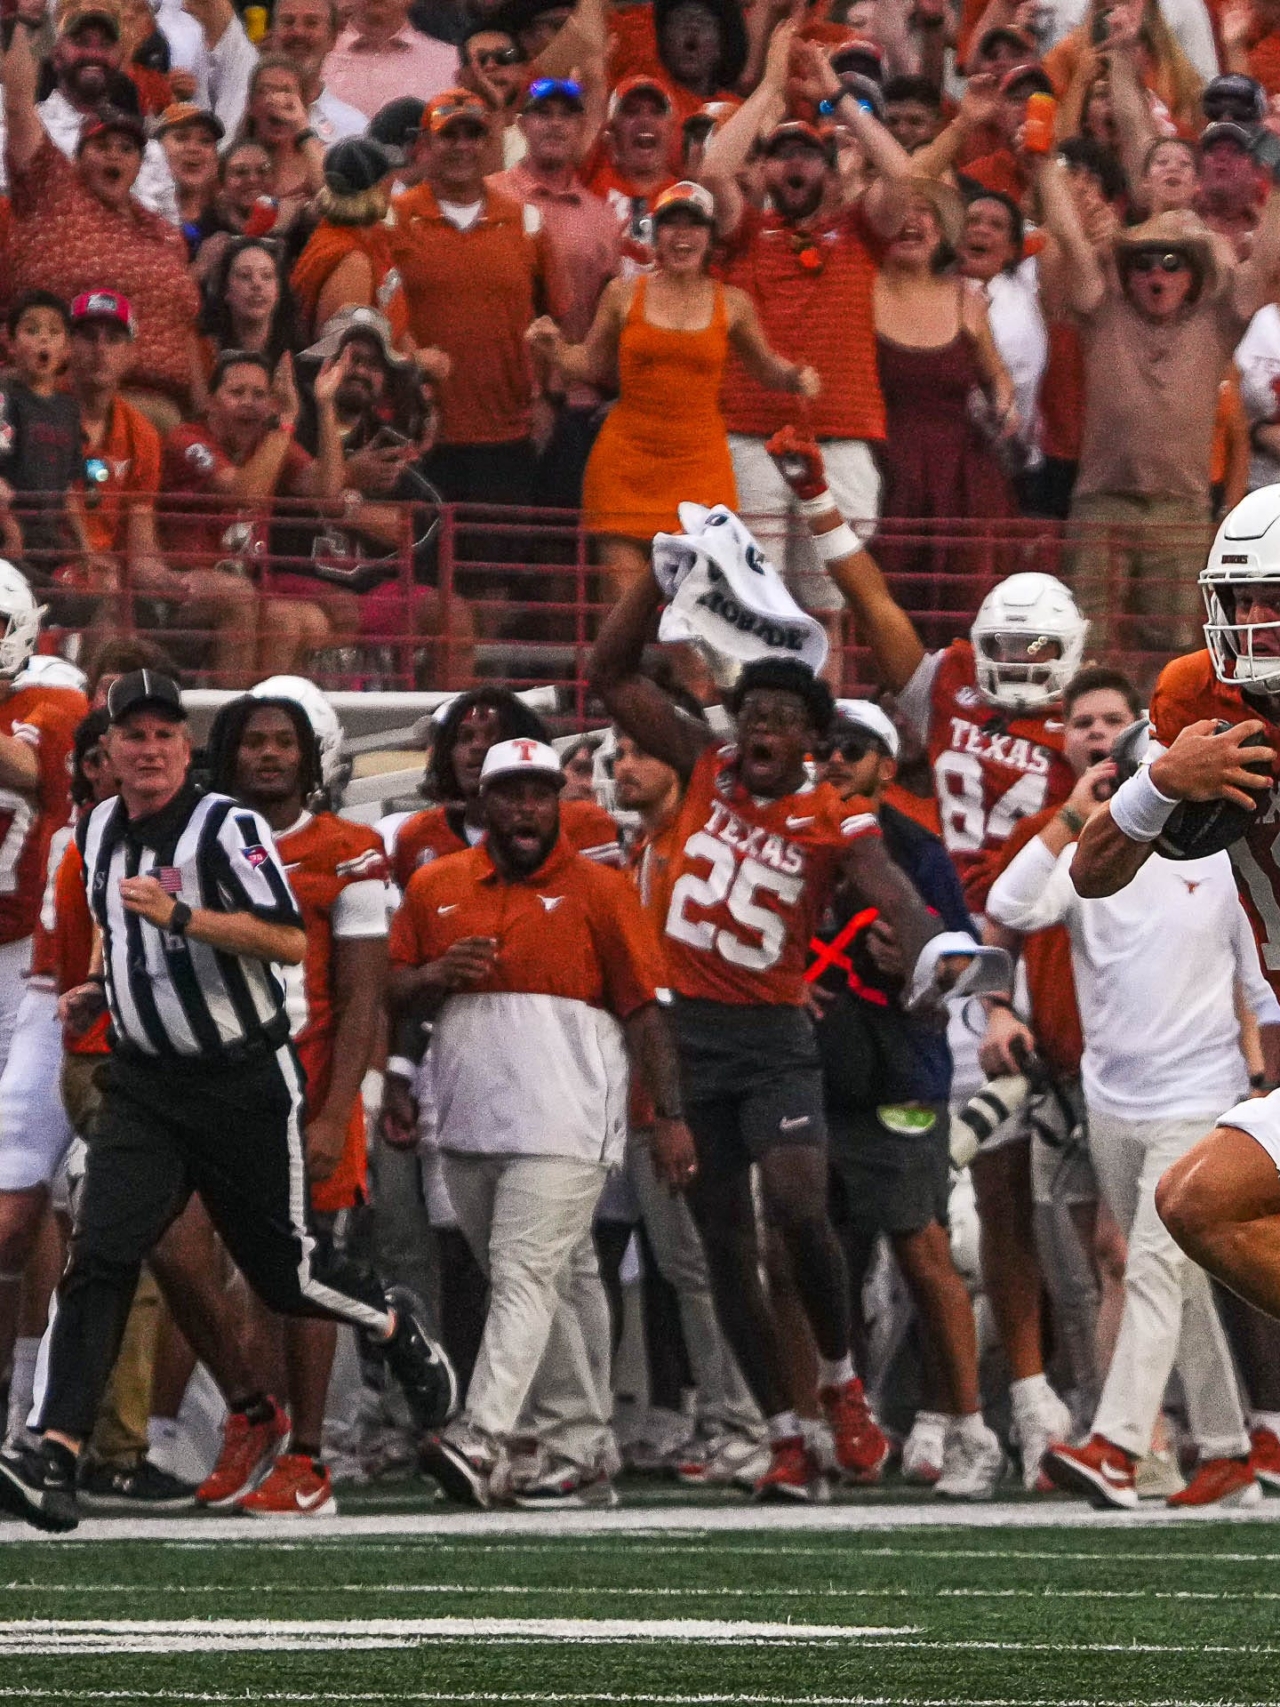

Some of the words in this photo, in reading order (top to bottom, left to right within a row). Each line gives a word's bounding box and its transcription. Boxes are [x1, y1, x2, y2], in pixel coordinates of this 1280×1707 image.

[512, 740, 538, 761] T
[951, 717, 1050, 774] TEXAS
[703, 799, 803, 874] TEXAS
[935, 750, 1048, 852] 84
[665, 831, 805, 970] 25
